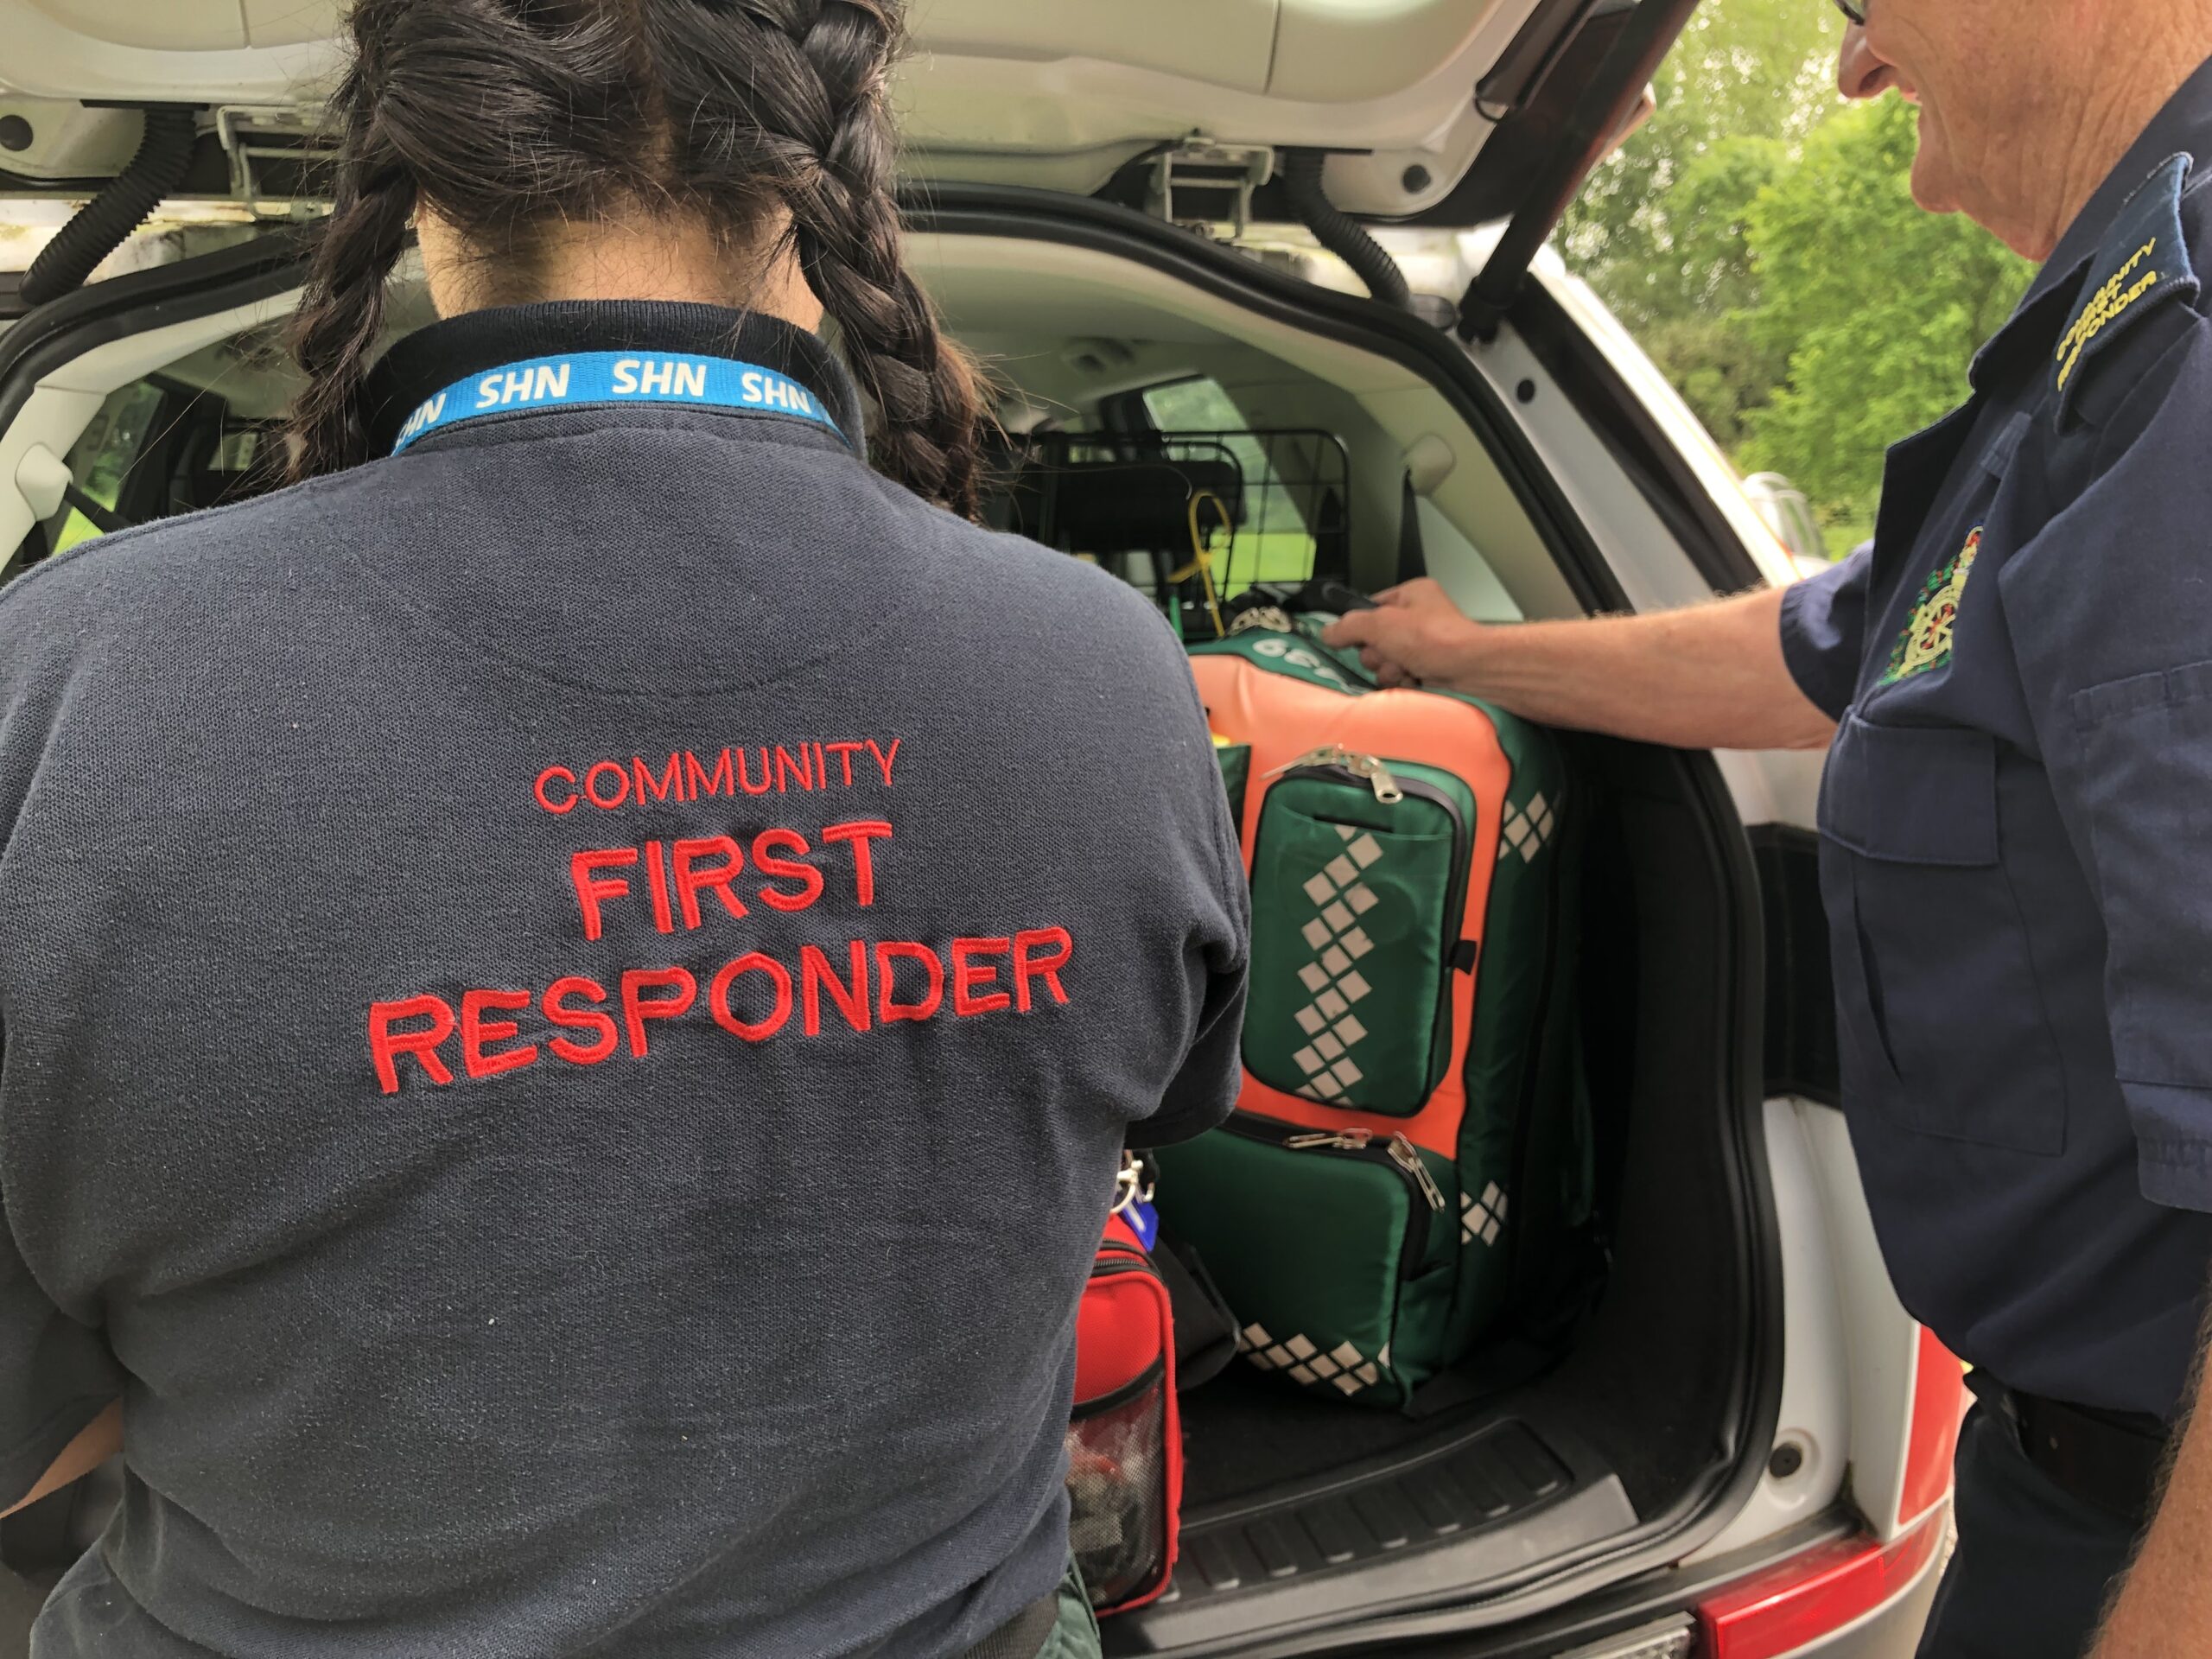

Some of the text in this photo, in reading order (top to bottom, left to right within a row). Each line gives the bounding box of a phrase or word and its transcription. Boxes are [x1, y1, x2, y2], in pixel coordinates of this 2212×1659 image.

[475, 363, 570, 409] SHN
[612, 359, 707, 397] SHN
[741, 372, 813, 414] SHN
[533, 740, 900, 815] COMMUNITY
[570, 821, 893, 942] FIRST
[368, 926, 1073, 1094] RESPONDER
